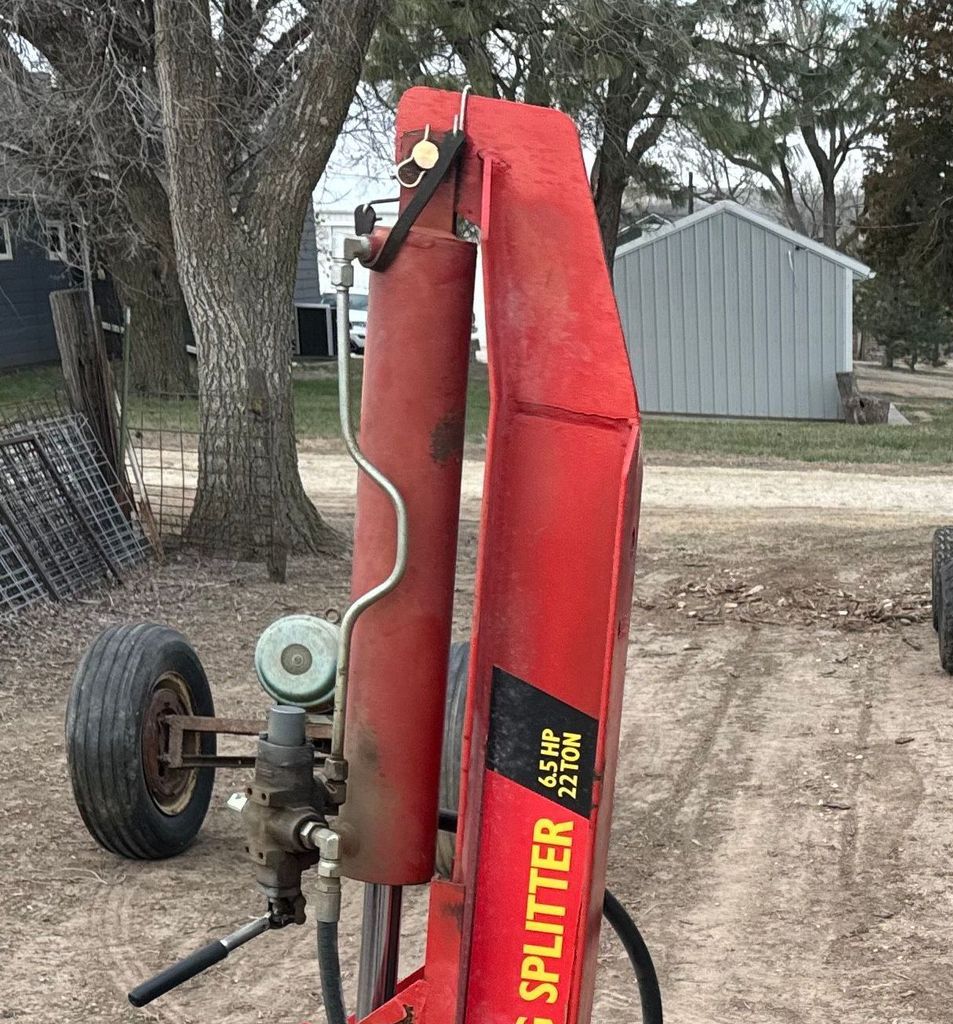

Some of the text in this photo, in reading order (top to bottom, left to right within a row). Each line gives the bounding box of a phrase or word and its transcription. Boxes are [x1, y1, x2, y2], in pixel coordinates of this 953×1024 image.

[538, 728, 560, 788] 6.5 HP
[557, 732, 581, 799] 22 TON
[519, 817, 575, 1004] SPLITTER
